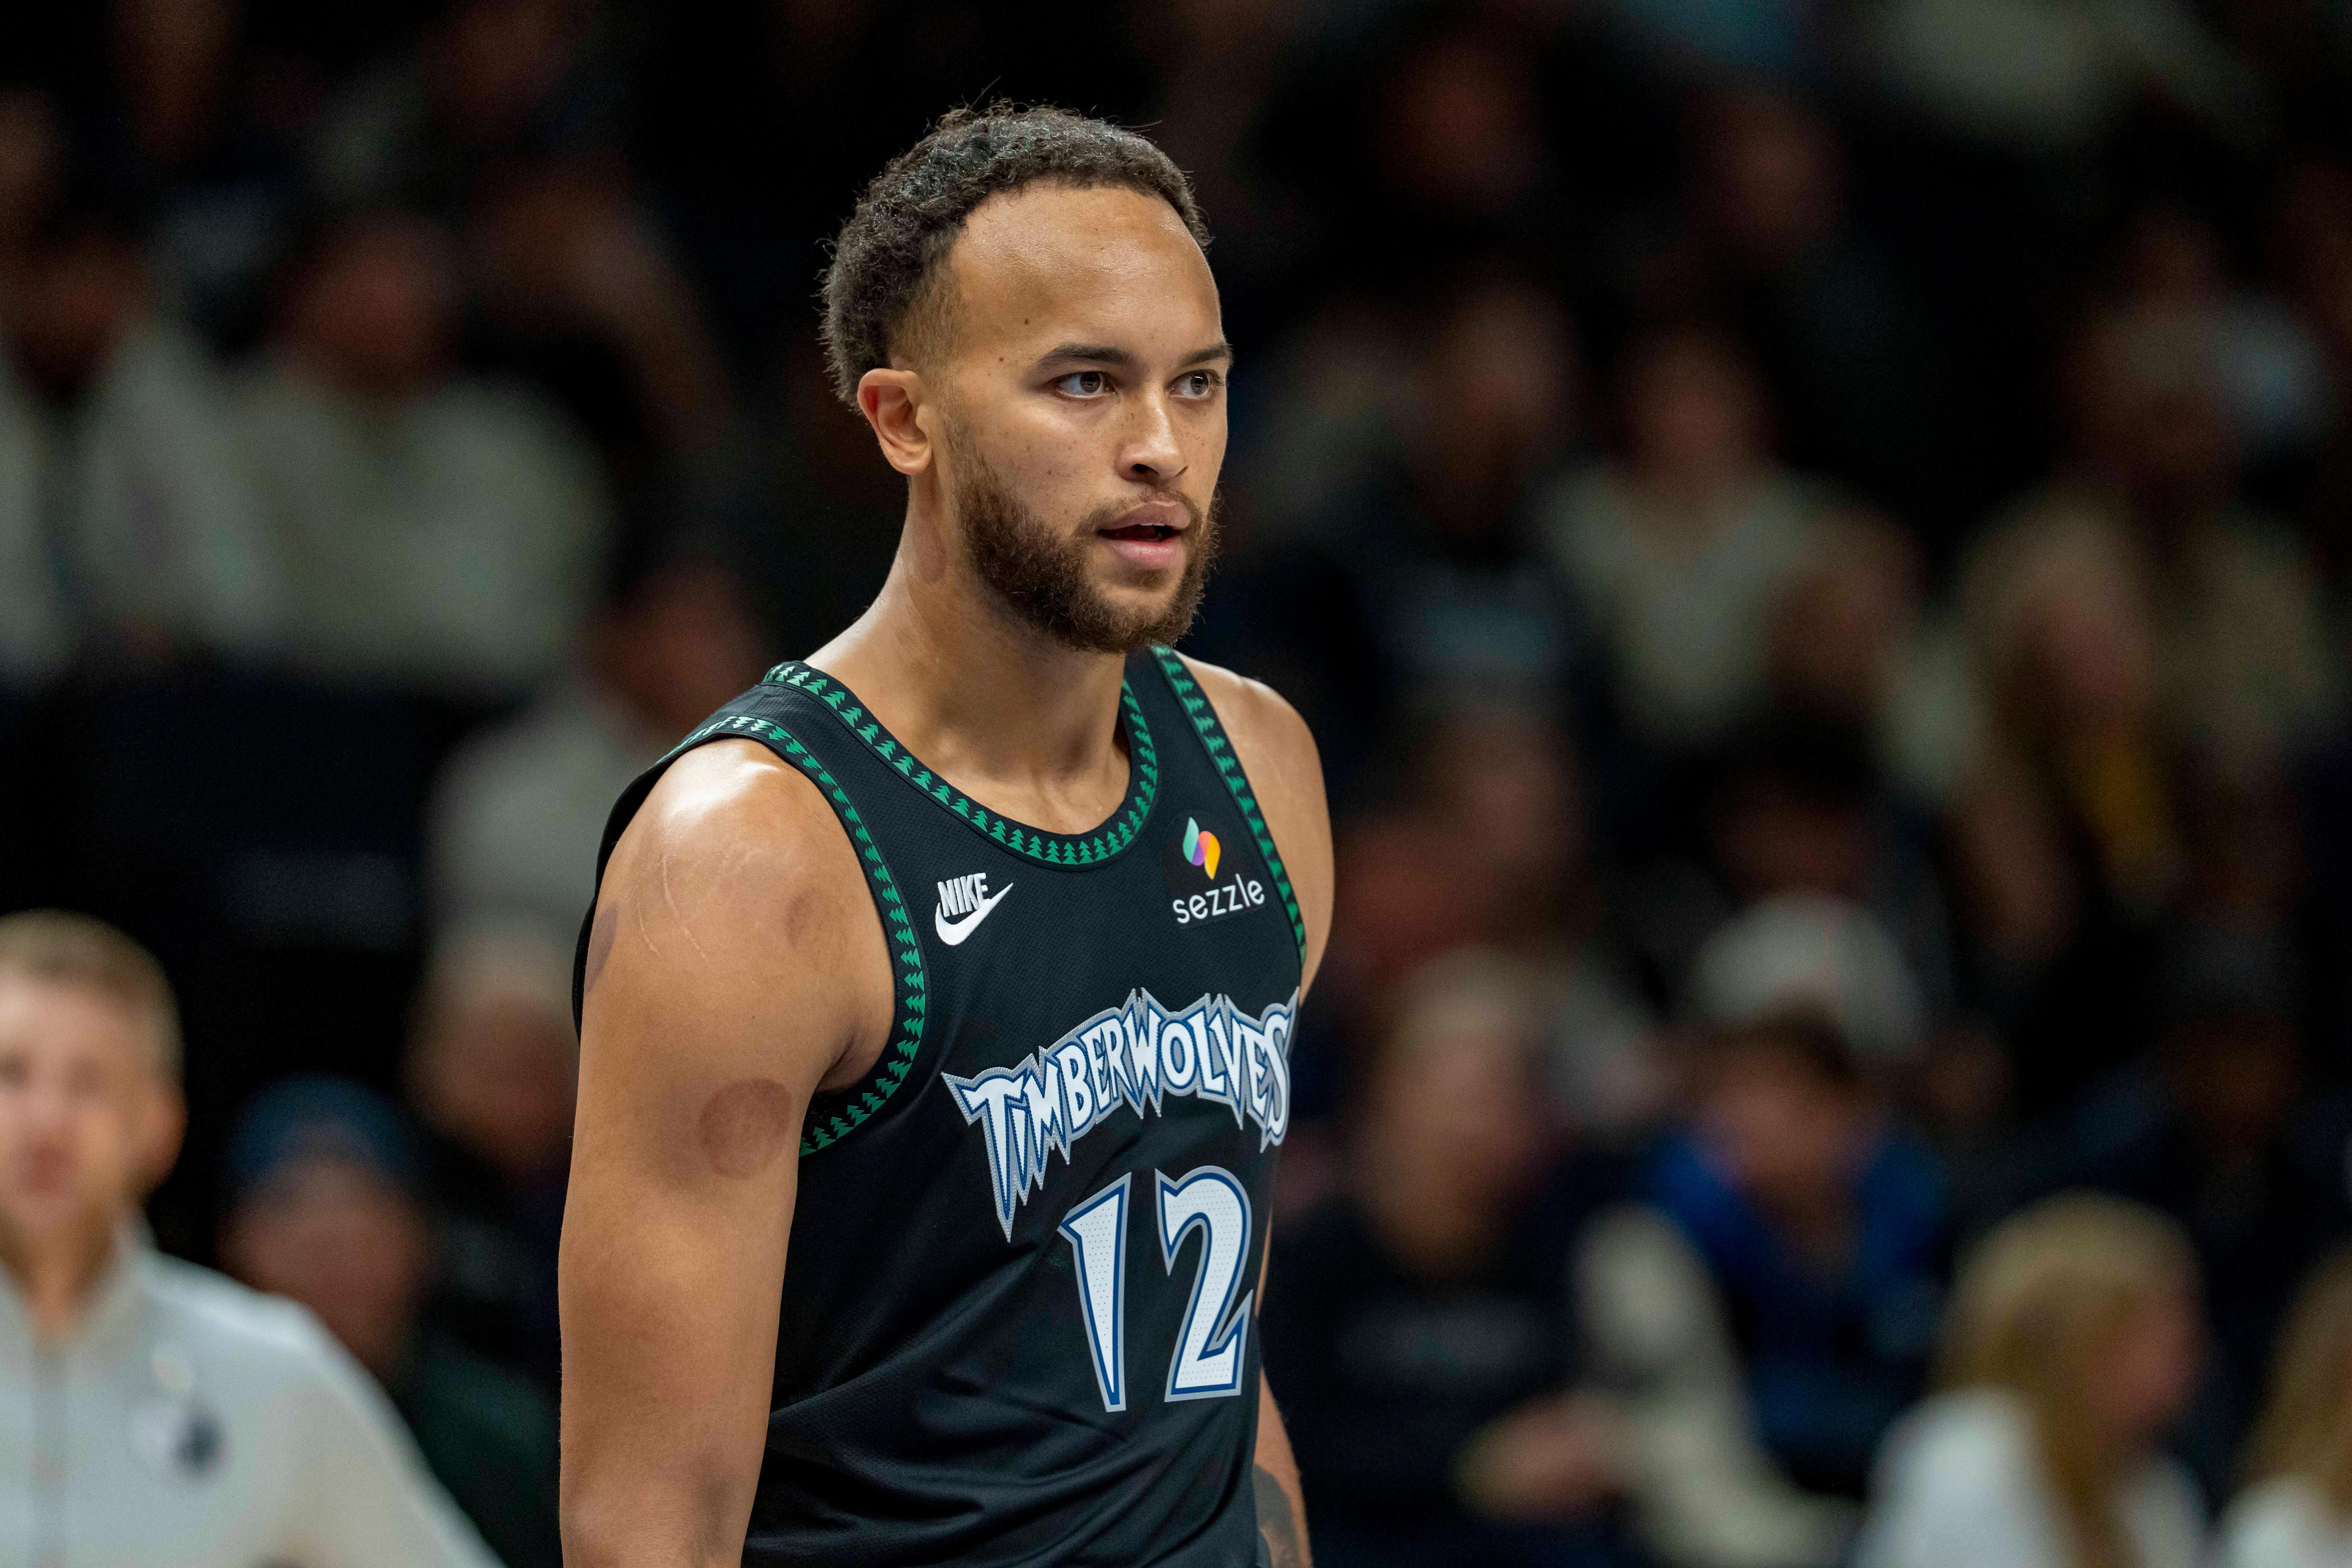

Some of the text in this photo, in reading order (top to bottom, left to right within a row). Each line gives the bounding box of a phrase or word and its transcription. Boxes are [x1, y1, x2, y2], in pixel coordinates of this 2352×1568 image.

[937, 872, 988, 917] NIKE
[1173, 874, 1265, 924] sezzle
[941, 987, 1300, 1242] TIMBERWOLVES
[1057, 1165, 1253, 1412] 12
